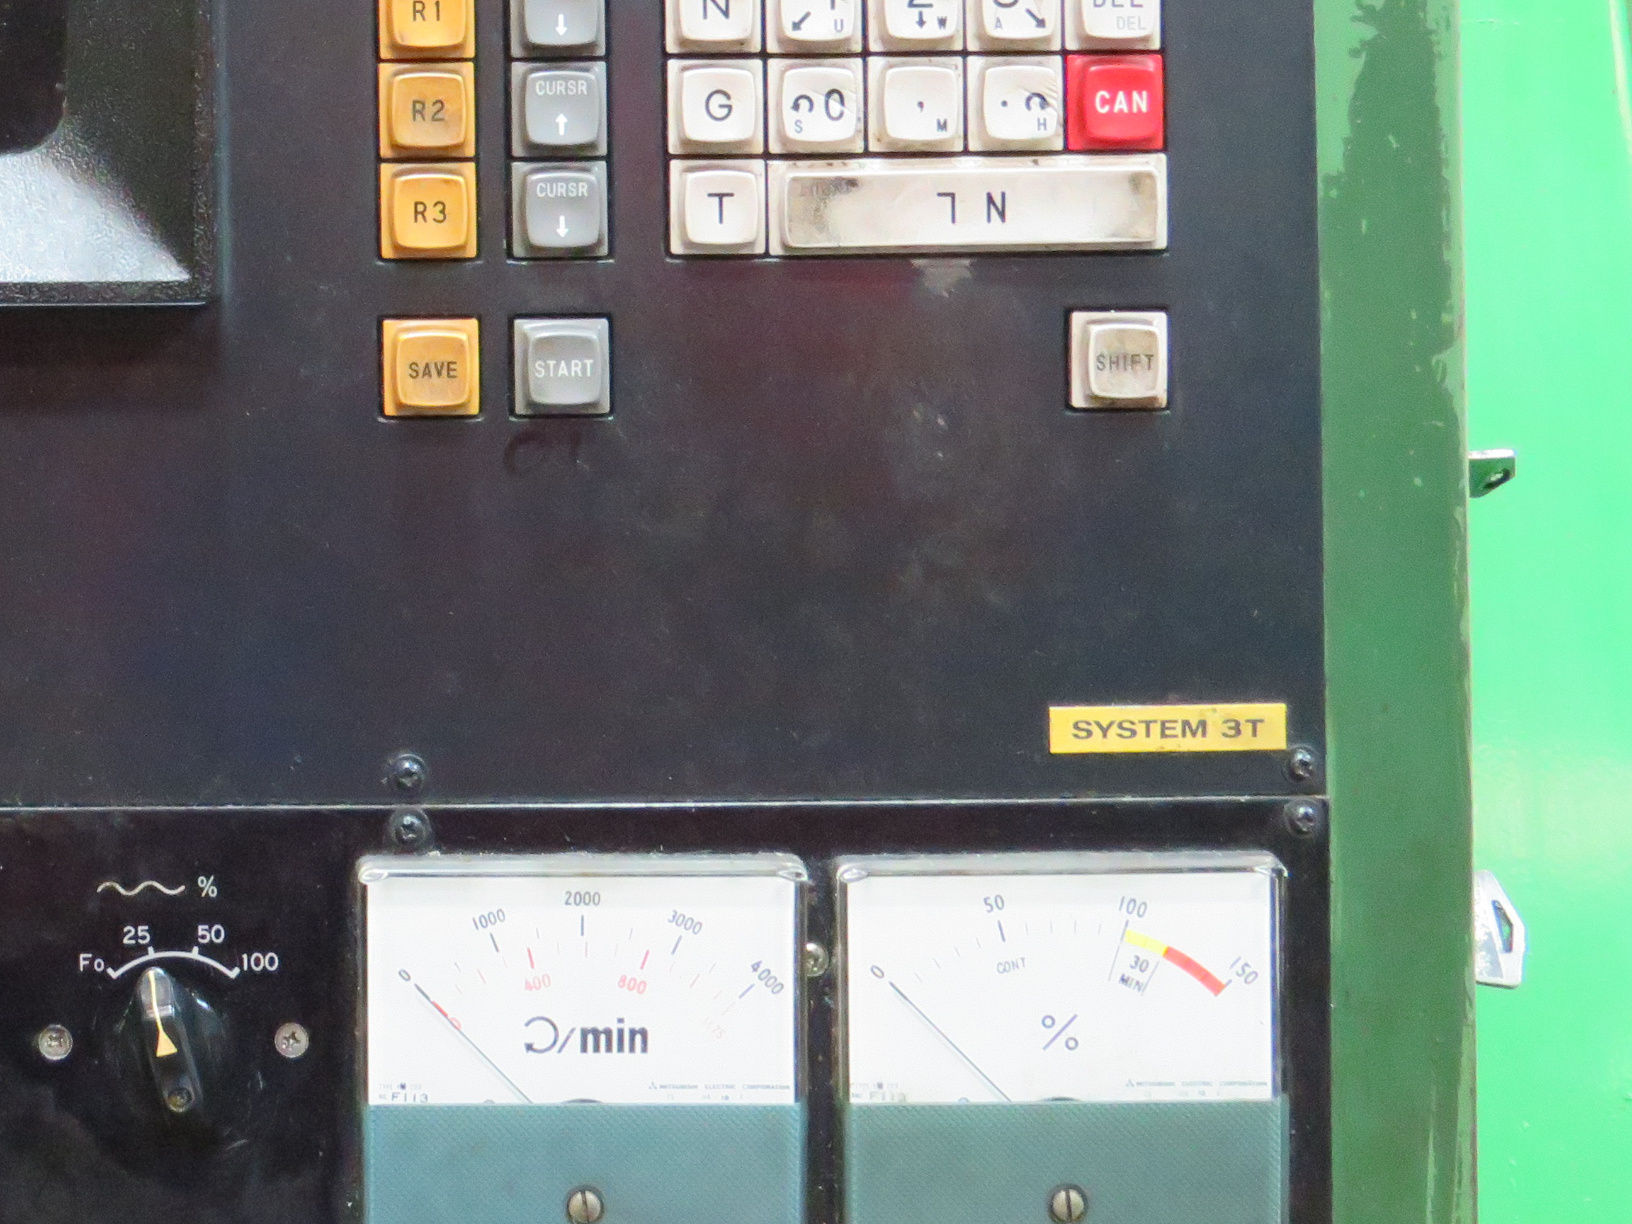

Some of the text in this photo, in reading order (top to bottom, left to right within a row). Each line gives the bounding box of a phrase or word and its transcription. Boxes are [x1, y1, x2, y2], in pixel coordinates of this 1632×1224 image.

[412, 1, 441, 21] R1
[834, 19, 844, 34] U
[1117, 16, 1148, 32] DEL
[535, 81, 588, 95] CURSR
[412, 100, 446, 122] R2
[704, 89, 733, 122] G
[1095, 90, 1149, 113] CAN
[794, 119, 803, 134] S
[536, 182, 588, 198] CURSR
[413, 201, 447, 223] R3
[707, 192, 734, 225] T
[408, 362, 458, 379] SAVE
[534, 359, 594, 377] START
[1096, 353, 1154, 372] SHIFT
[1072, 718, 1265, 740] SYSTEM 3T
[197, 876, 218, 897] %
[564, 891, 601, 907] 2000
[983, 895, 1005, 912] 50
[1118, 896, 1148, 918] 100
[472, 909, 506, 931] 1000
[667, 909, 703, 935] 3000
[123, 926, 151, 944] 25
[197, 925, 226, 944] 50
[241, 952, 279, 971] 100
[996, 957, 1027, 974] CONT
[1129, 956, 1150, 973] 30
[1230, 956, 1258, 985] 150
[398, 968, 411, 983] 0
[750, 960, 785, 995] 4000
[870, 966, 885, 979] 0
[524, 974, 552, 992] 400
[618, 974, 647, 995] 800
[1118, 974, 1145, 993] MIN
[1042, 1014, 1079, 1050] %
